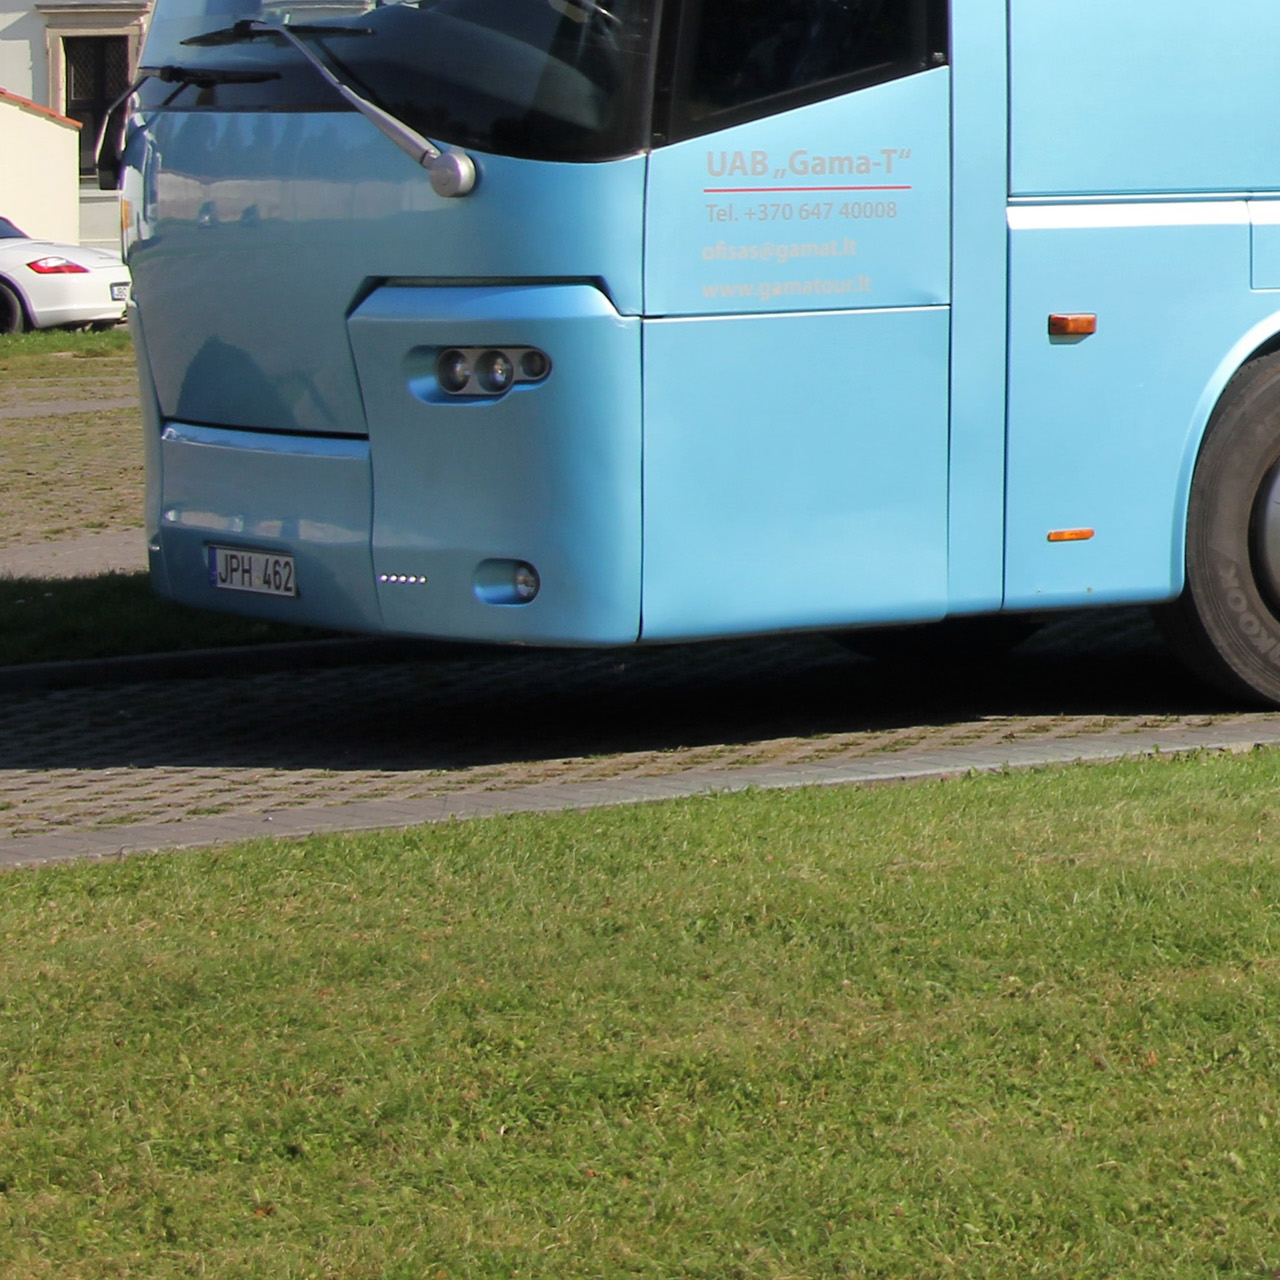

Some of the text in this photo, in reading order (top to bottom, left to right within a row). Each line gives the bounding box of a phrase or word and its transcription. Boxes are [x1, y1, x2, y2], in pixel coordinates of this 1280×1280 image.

[706, 150, 769, 177] UAB
[705, 200, 898, 223] Tel. +370 647 40008
[219, 553, 293, 592] JPH 462
